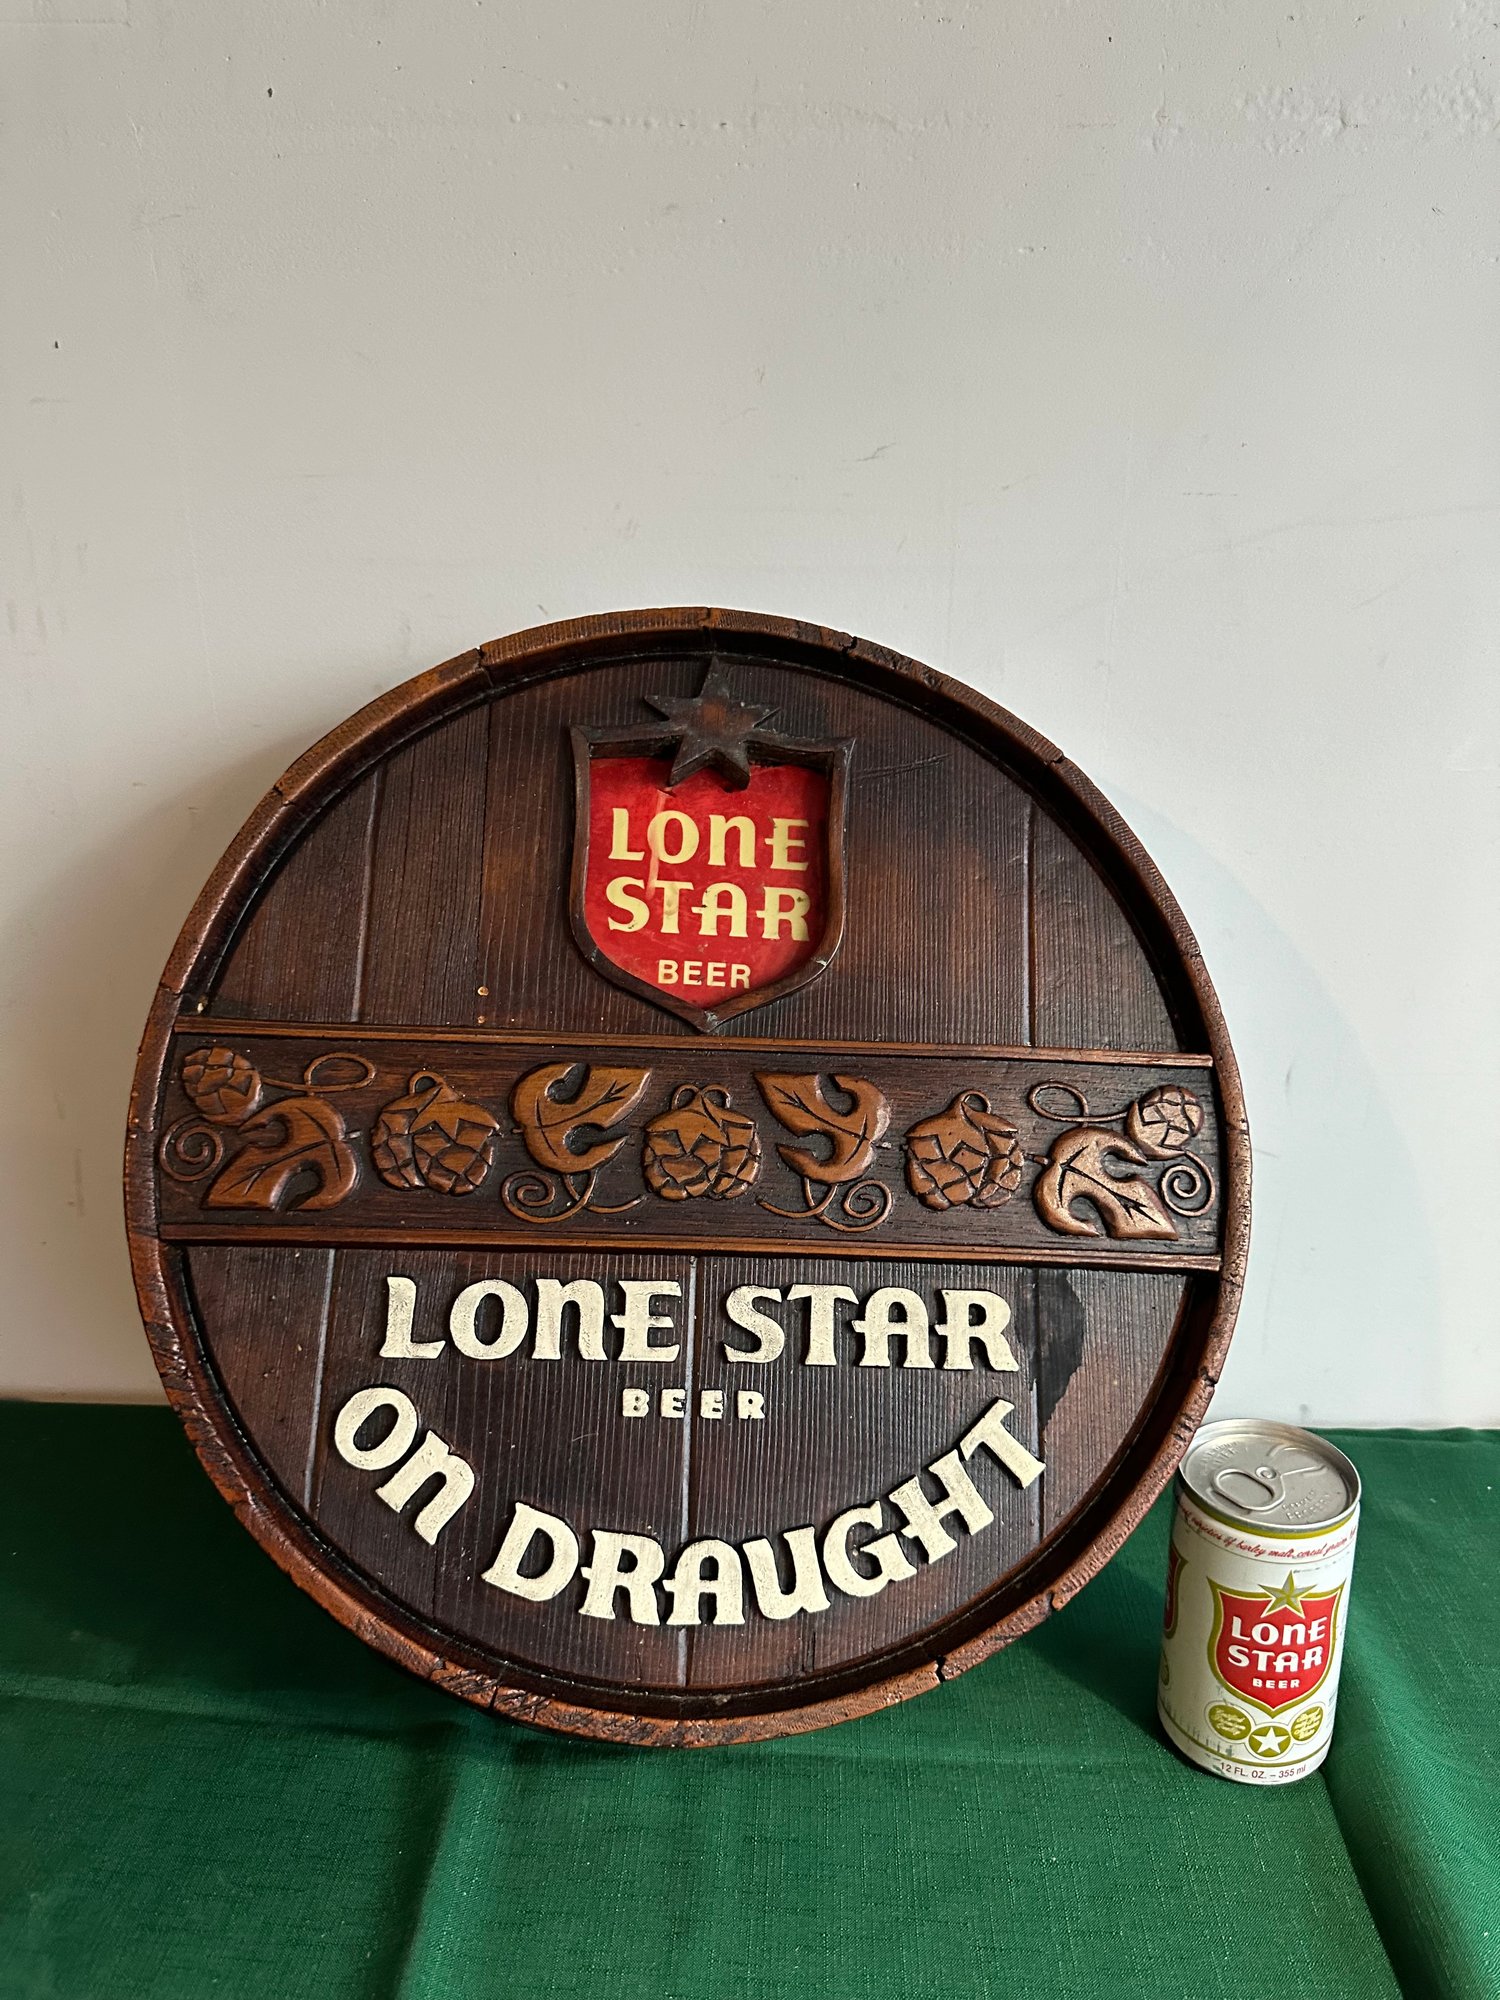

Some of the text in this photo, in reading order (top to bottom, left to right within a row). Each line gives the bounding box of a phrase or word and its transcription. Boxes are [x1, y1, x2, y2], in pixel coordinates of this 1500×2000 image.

[608, 807, 810, 872] LONE
[605, 876, 811, 942] STAR
[657, 959, 751, 989] BEER
[379, 1276, 1020, 1372] LONE STAR
[621, 1387, 766, 1420] BEER
[480, 1398, 1046, 1626] DRAUGHT
[1231, 1615, 1328, 1646] LONE
[1227, 1644, 1324, 1673] STAR
[1252, 1677, 1300, 1689] BEER
[1220, 1762, 1232, 1773] 12
[1233, 1766, 1249, 1778] FL.
[1278, 1767, 1295, 1779] 355
